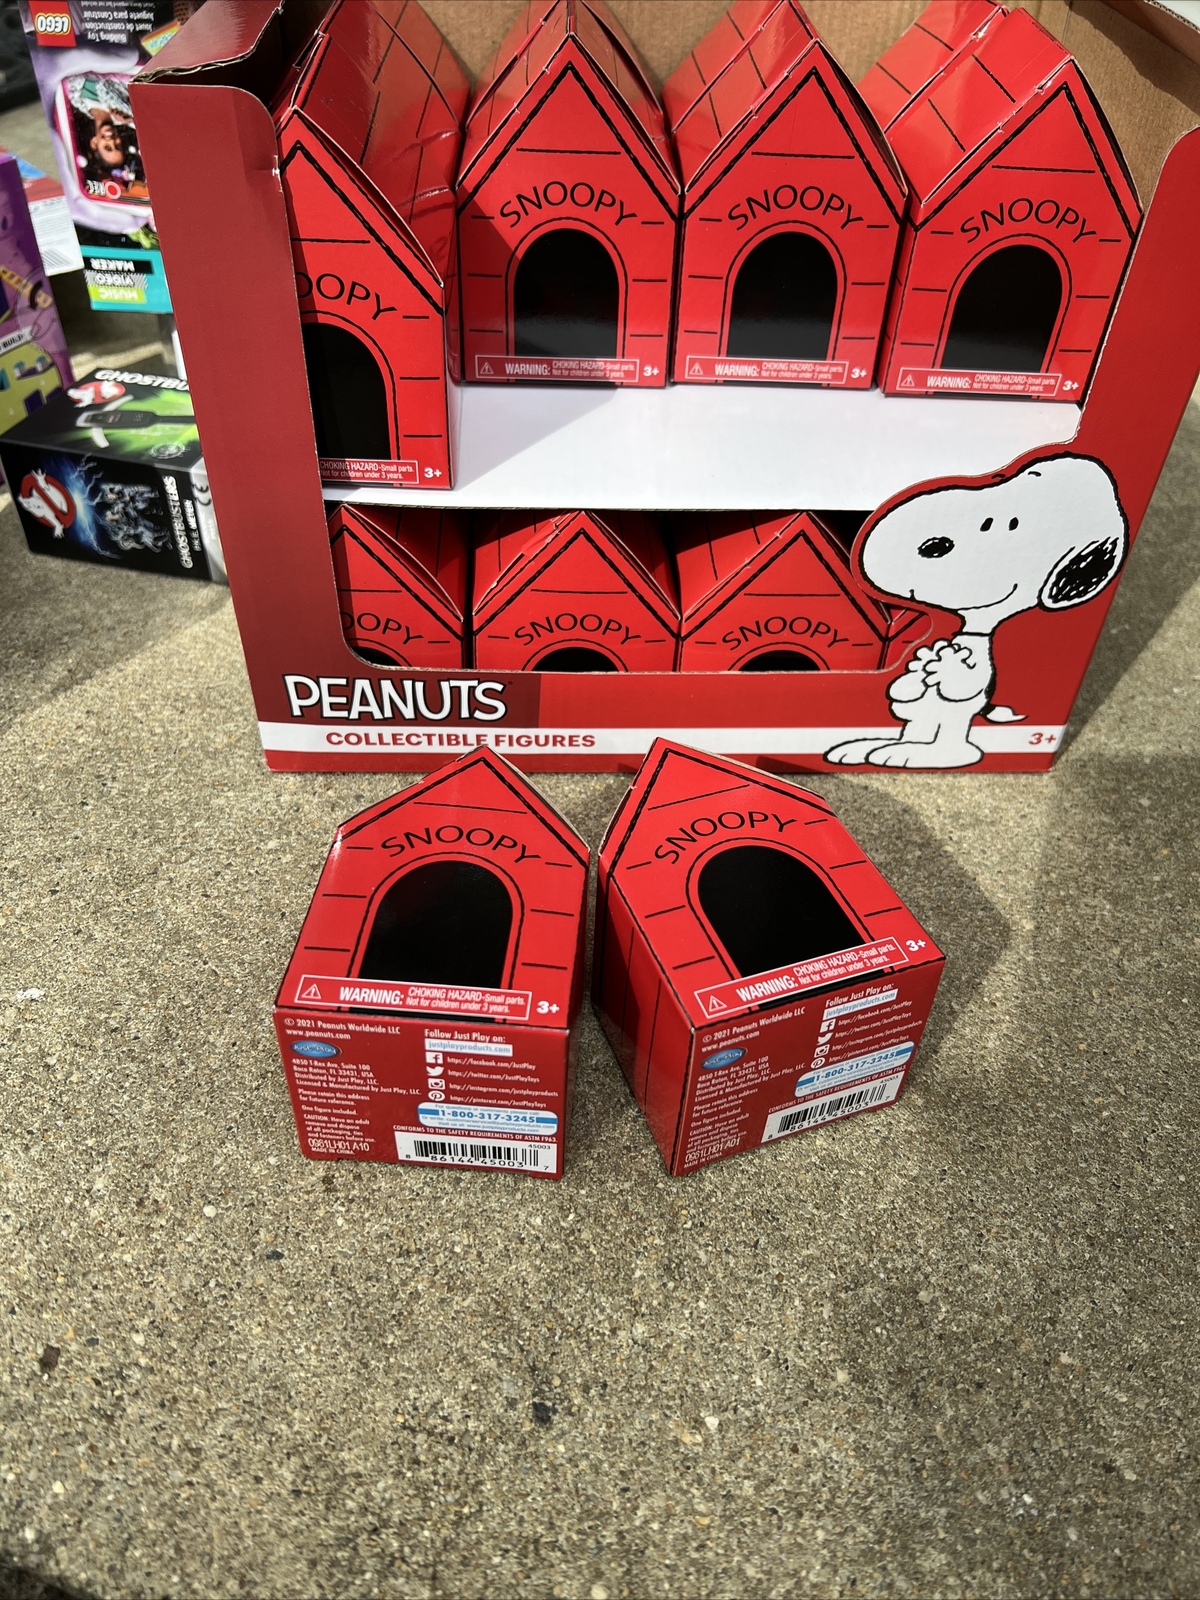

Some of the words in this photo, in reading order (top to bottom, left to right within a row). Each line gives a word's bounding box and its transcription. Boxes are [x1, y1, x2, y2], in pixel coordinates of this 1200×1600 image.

[36, 14, 70, 34] LEGO
[87, 32, 99, 42] Toy
[100, 32, 127, 43] Building
[500, 181, 637, 228] SNOOPY
[728, 184, 864, 231] SNOOPY
[960, 198, 1097, 243] SNOOPY
[90, 258, 134, 272] MAKER
[95, 274, 133, 286] VIDEO
[98, 288, 138, 300] MUSIC
[505, 363, 550, 375] WARNING:
[643, 366, 659, 376] 3+
[715, 364, 759, 377] WARNING:
[851, 368, 866, 378] 3+
[927, 375, 971, 389] WARNING:
[1063, 380, 1079, 391] 3+
[320, 461, 349, 470] CHOKING
[424, 468, 442, 478] 3+
[162, 475, 193, 568] GHOSTBUSTERS
[183, 499, 197, 529] METER
[514, 613, 642, 646] SNOOPY
[722, 616, 849, 651] SNOOPY
[282, 674, 507, 721] PEANUTS
[326, 732, 488, 747] COLLECTIBLE
[495, 734, 595, 747] FIGURES
[1029, 733, 1057, 746] 3+
[381, 825, 541, 864] SNOOPY
[655, 811, 797, 864] SNOOPY
[906, 939, 926, 952] 3+
[793, 960, 827, 976] CHOKING
[878, 943, 896, 955] parts.
[799, 975, 812, 984] Not
[812, 972, 821, 981] for
[821, 968, 847, 979] children
[846, 961, 864, 972] under
[864, 958, 871, 966] 3
[871, 955, 890, 966] years.
[340, 987, 404, 1005] WARNING:
[408, 987, 446, 999] CHOKING
[505, 996, 525, 1005] parts.
[736, 975, 798, 1002] WARNING:
[825, 996, 848, 1008] Follow
[850, 991, 864, 1000] Just
[865, 986, 881, 997] Play
[882, 983, 894, 991] on:
[406, 997, 419, 1005] Not
[420, 998, 430, 1007] for
[431, 999, 460, 1009] children
[461, 1001, 481, 1011] under
[483, 1002, 487, 1011] 3
[489, 1004, 510, 1013] years.
[537, 1001, 559, 1014] 3+
[826, 992, 895, 1018] justplayproducts.com
[297, 1019, 315, 1027] 2021
[318, 1021, 346, 1030] Peanuts
[348, 1023, 386, 1033] Worldwide
[388, 1026, 400, 1034] LLC
[713, 1029, 730, 1040] 2021
[732, 1022, 758, 1035] Peanuts
[759, 1011, 793, 1026] Worldwide
[794, 1003, 805, 1016] LLC
[286, 1029, 351, 1039] www.peanuts.com
[425, 1029, 451, 1038] Follow
[471, 1033, 490, 1042] Play
[701, 1030, 760, 1053] www.peanuts.com
[428, 1041, 511, 1053] justplayproducts.com
[814, 1051, 896, 1082] 1-800-317-3245
[440, 1110, 536, 1123] 1-800-317-3245
[393, 1125, 425, 1133] CONFORMS
[470, 1130, 514, 1139] REQUIREMENTS
[353, 1142, 369, 1151] A10
[431, 1155, 473, 1163] 86144
[481, 1159, 524, 1168] 45003
